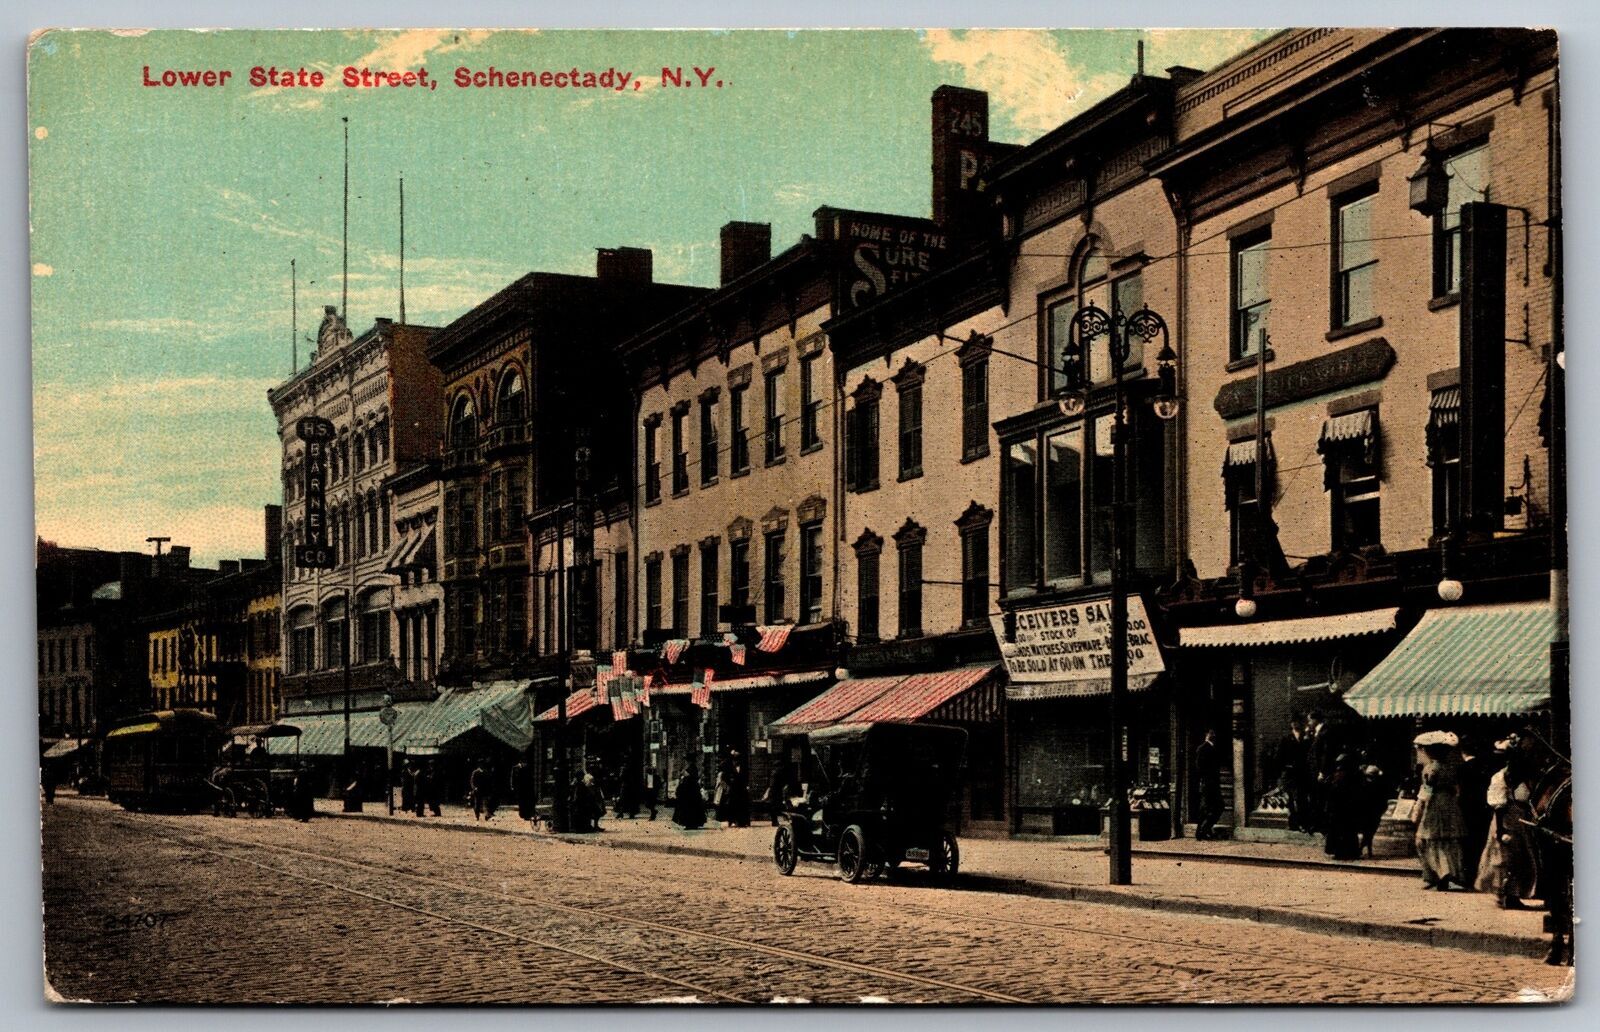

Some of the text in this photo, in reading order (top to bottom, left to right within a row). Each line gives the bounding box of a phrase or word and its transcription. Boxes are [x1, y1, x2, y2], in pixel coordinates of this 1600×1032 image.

[851, 222, 947, 249] HOME OF THE
[1014, 607, 1079, 630] CEIVERS
[1040, 629, 1064, 642] STOCK
[1066, 627, 1077, 639] OF
